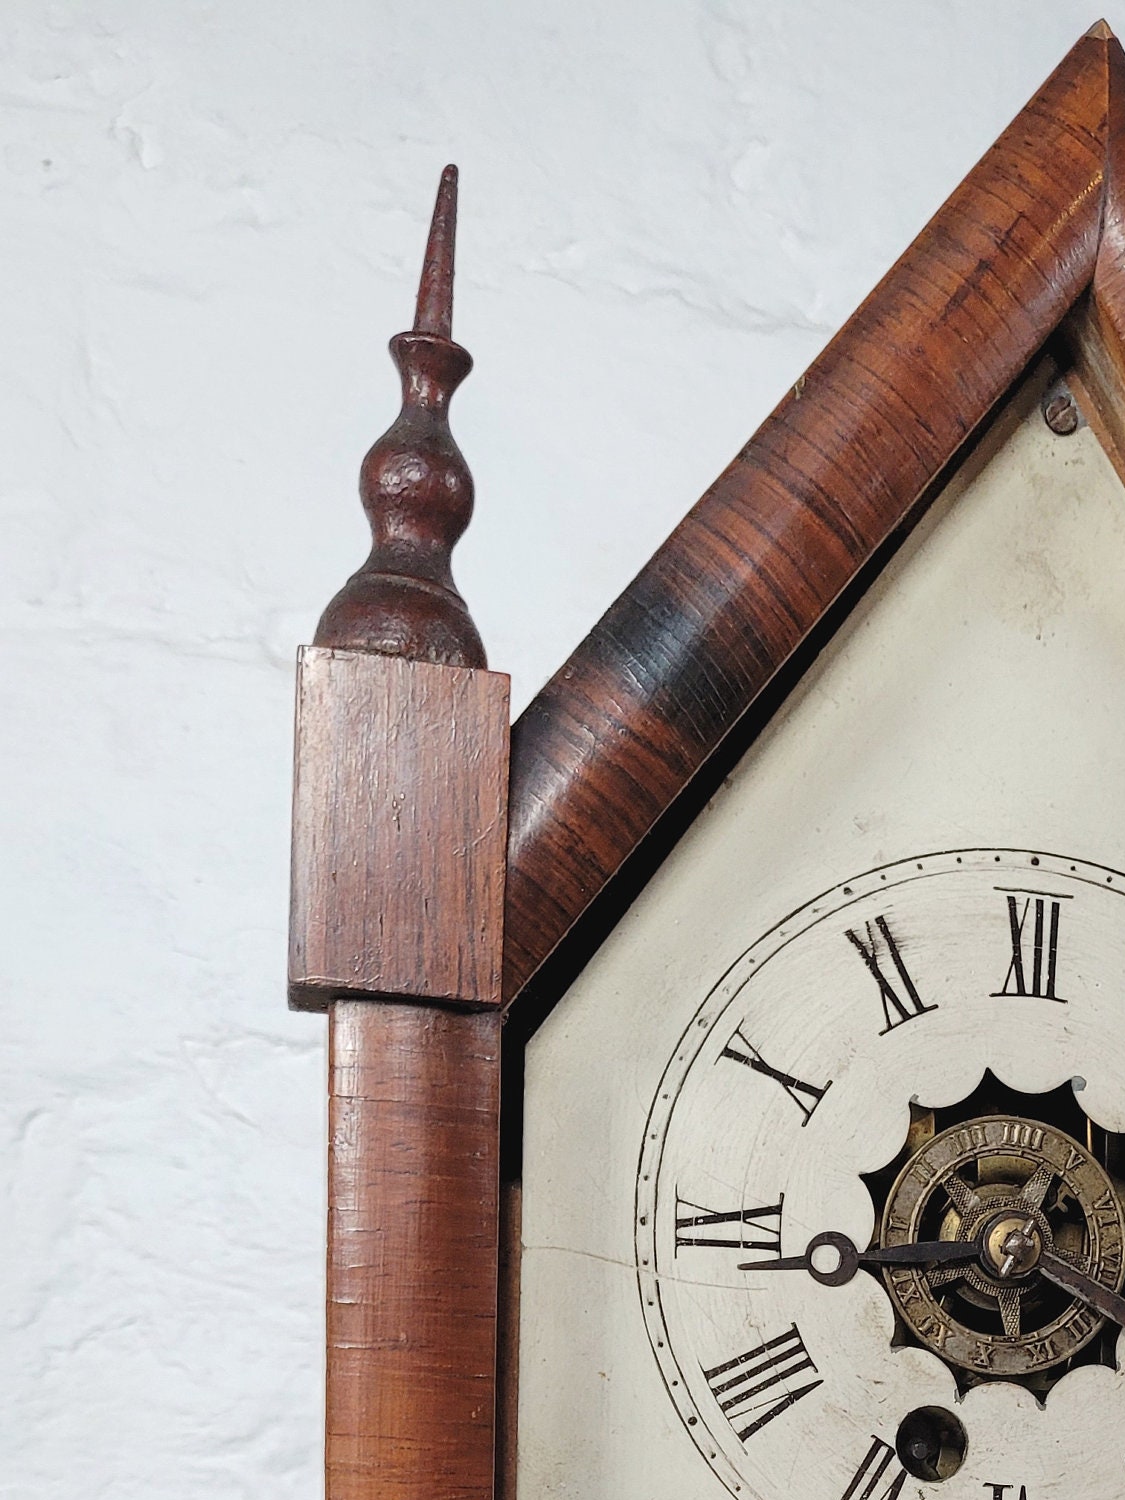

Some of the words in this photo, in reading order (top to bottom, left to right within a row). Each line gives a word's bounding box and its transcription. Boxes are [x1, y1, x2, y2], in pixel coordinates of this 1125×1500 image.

[844, 915, 939, 1036] XI
[989, 886, 1074, 1003] XII
[714, 1019, 834, 1127] X
[674, 1183, 785, 1260] IX
[702, 1322, 825, 1456] VIII
